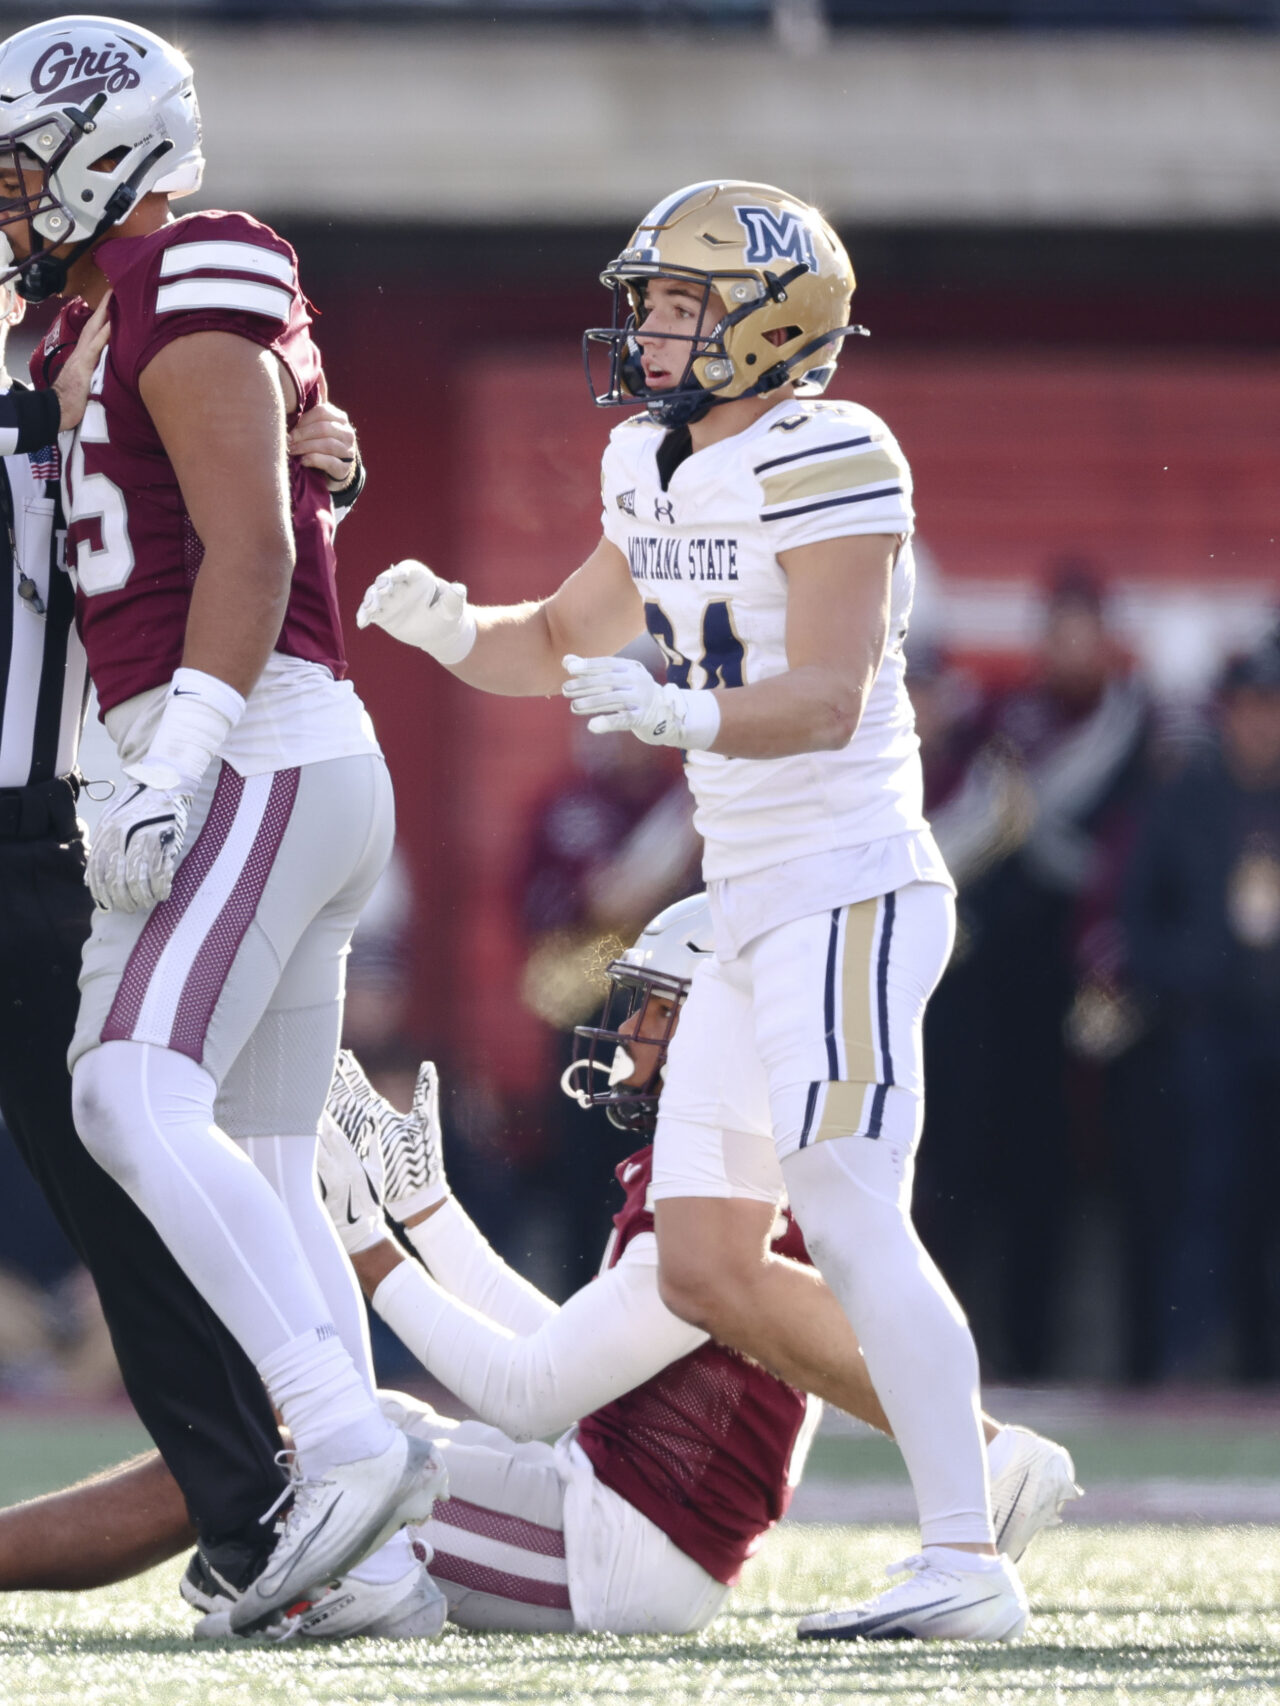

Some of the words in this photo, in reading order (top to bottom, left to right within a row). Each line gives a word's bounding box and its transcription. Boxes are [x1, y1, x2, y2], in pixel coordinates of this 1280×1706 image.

[30, 41, 141, 95] Griz
[733, 205, 818, 274] M
[627, 536, 682, 580] MONTANA
[688, 538, 739, 580] STATE
